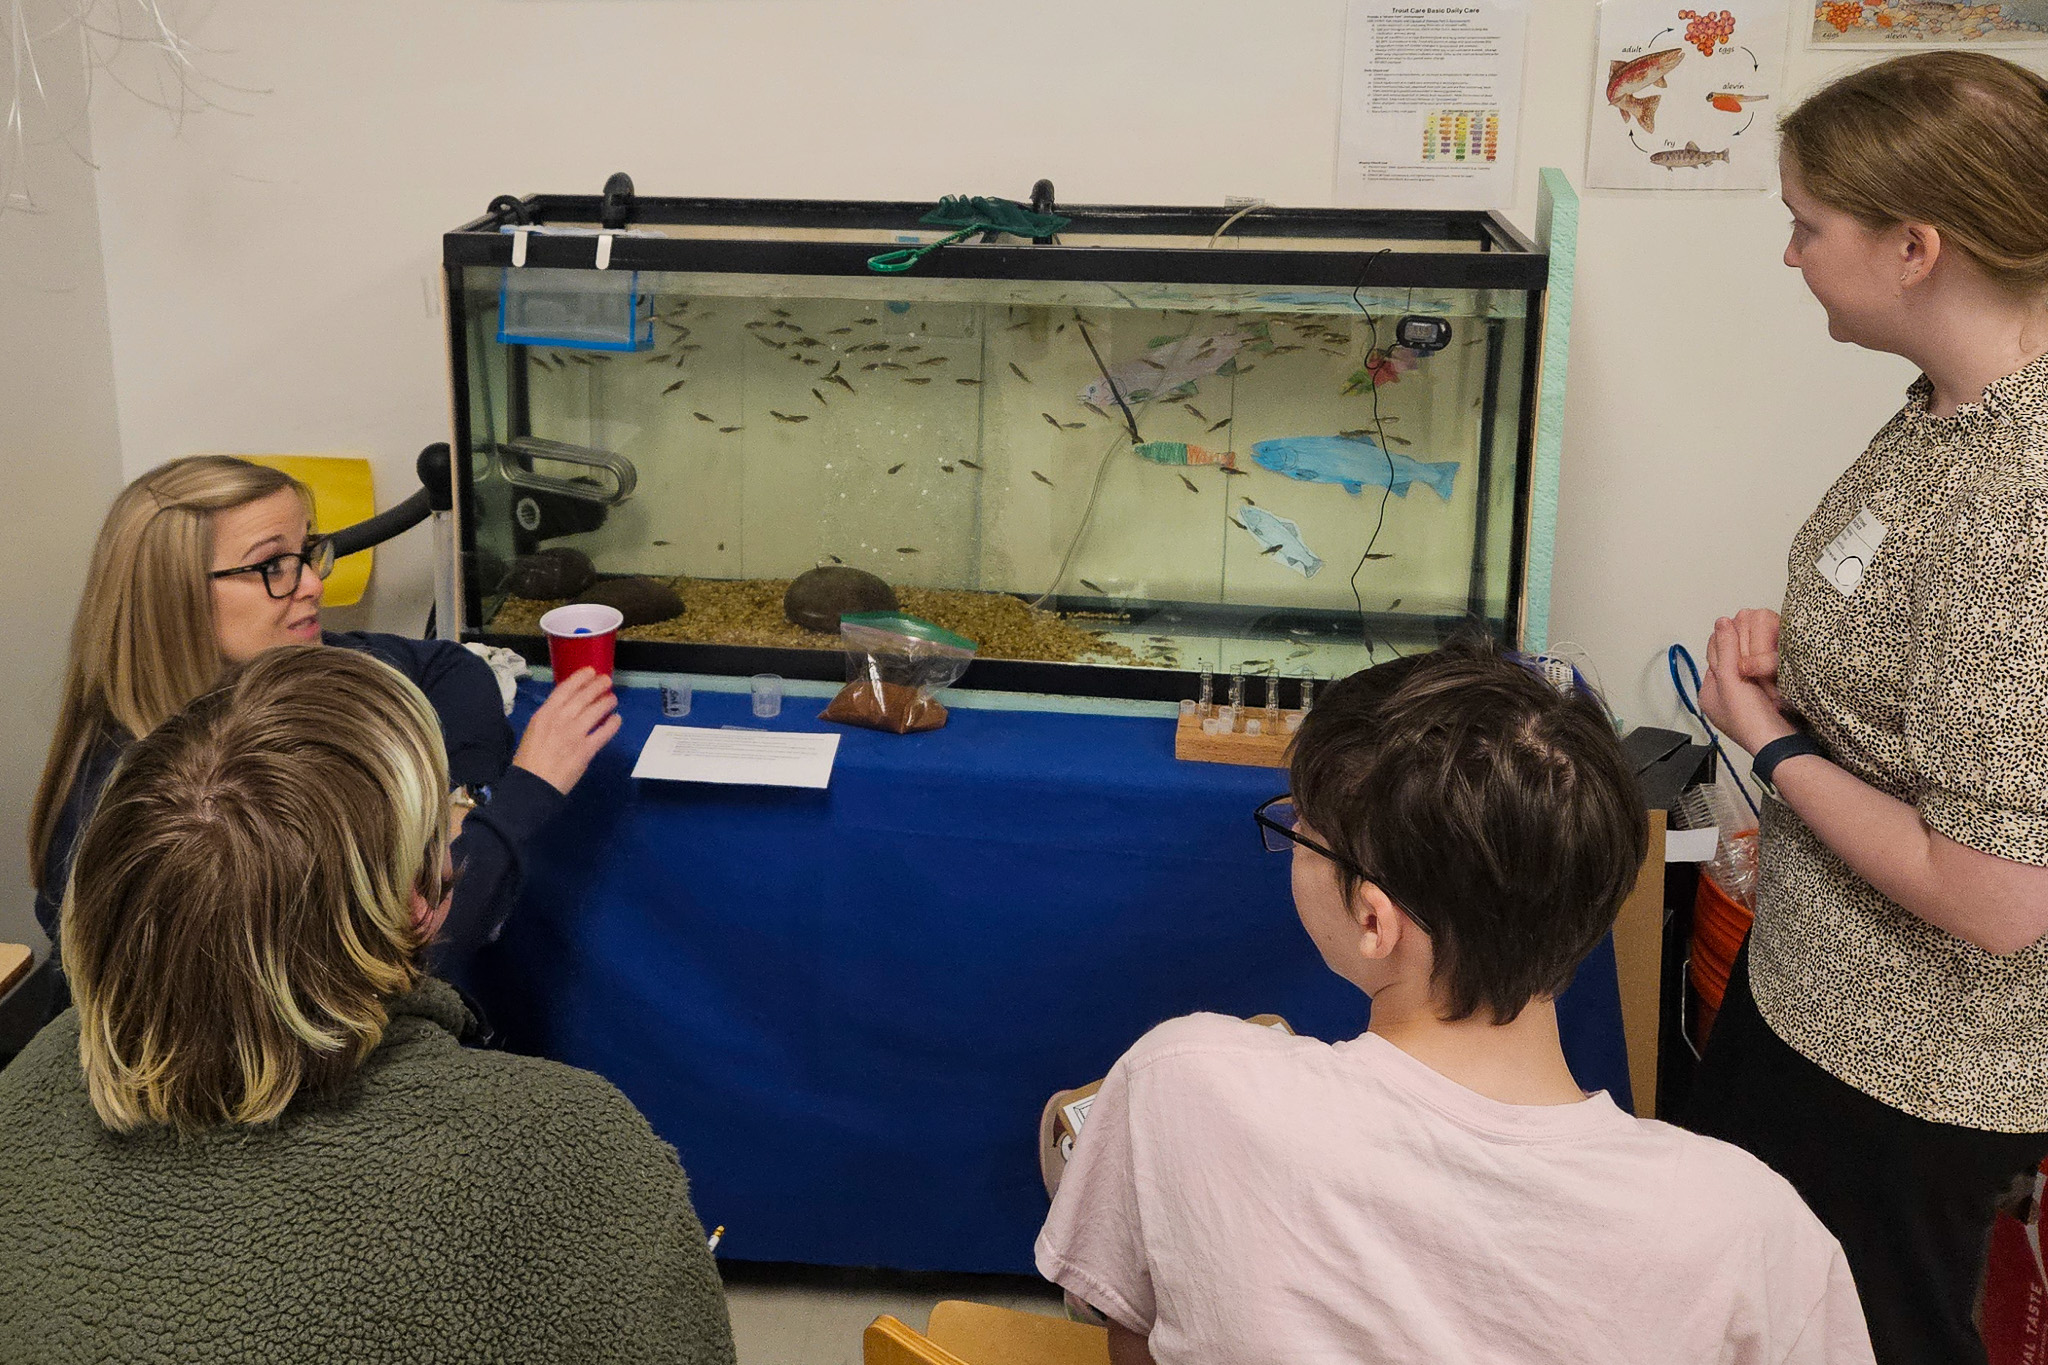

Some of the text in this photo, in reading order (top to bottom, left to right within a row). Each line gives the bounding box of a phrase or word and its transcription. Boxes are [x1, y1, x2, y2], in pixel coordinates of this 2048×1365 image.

[1446, 7, 1463, 15] Daily
[1718, 46, 1735, 55] eggs
[1722, 82, 1745, 90] alevin
[1663, 139, 1676, 148] fry
[2026, 1282, 2042, 1335] TASTE
